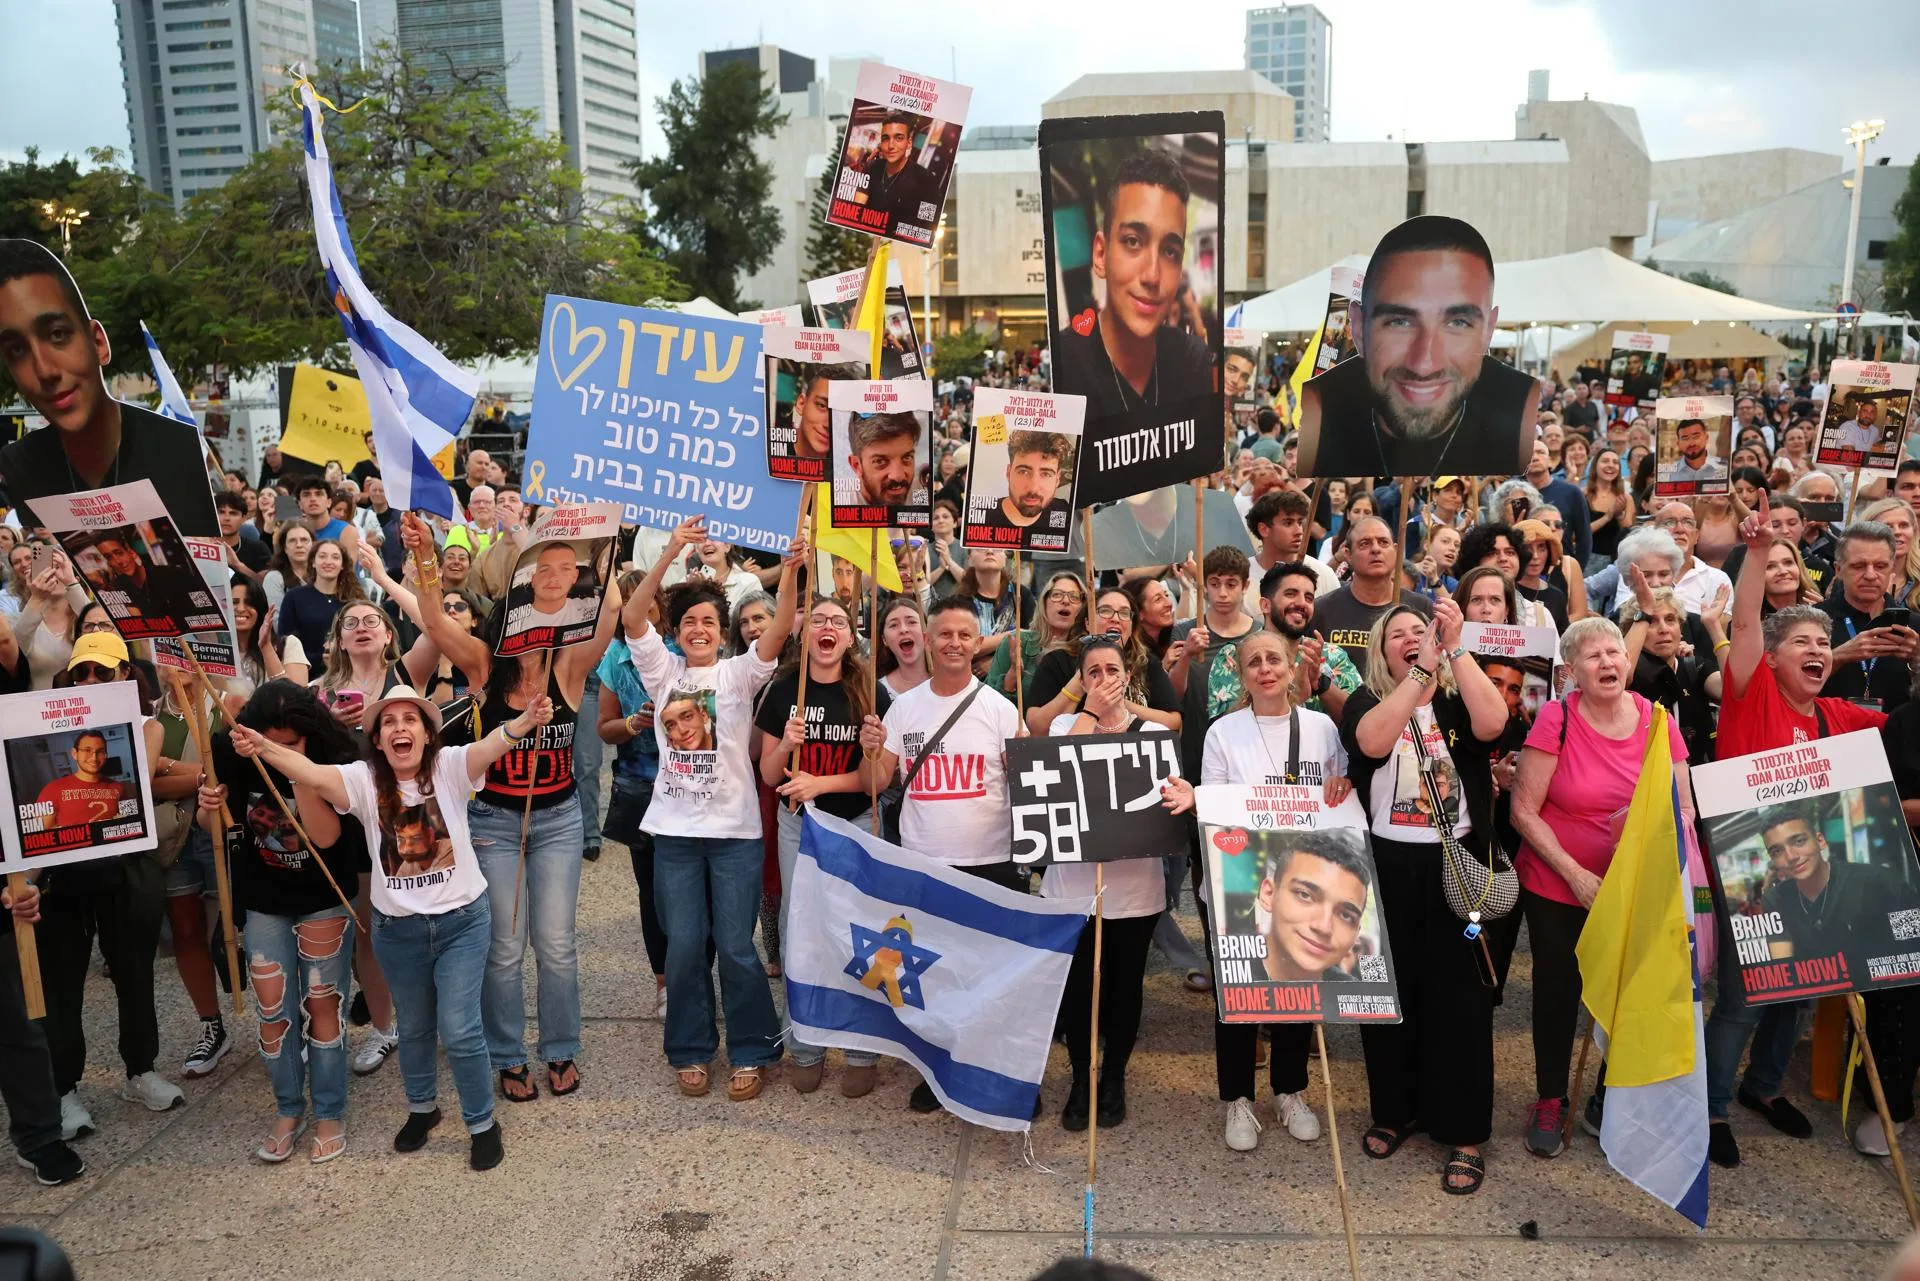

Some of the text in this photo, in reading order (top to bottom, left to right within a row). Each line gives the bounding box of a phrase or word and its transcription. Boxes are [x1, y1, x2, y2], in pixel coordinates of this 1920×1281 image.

[890, 83, 939, 103] EDAN ALEXANDER
[840, 169, 871, 189] BRING
[836, 185, 857, 202] HIM
[833, 201, 859, 222] HOME
[862, 209, 889, 228] NOW!
[617, 318, 745, 390] עידן
[794, 341, 840, 352] EDAN ALEXANDER
[811, 351, 823, 361] (20)
[864, 393, 898, 402] DAVID CUNIO
[574, 382, 760, 437] כל כל חיכינו לך
[875, 402, 887, 411] (33)
[1003, 406, 1057, 419] GUY GILBOA-DALAL
[1014, 417, 1032, 428] (23)
[770, 426, 797, 443] BRING
[1824, 428, 1847, 438] BRING
[603, 420, 736, 468] כמה טוב
[770, 441, 788, 457] HIM
[1093, 419, 1195, 472] עידן אלכסנדר
[1821, 437, 1836, 448] HIM
[771, 458, 824, 475] HOME NOW!
[571, 453, 754, 511] שאתה בבית
[833, 478, 861, 492] BRING
[833, 491, 851, 506] HIM
[969, 494, 999, 510] BRING
[570, 515, 607, 527] KUPERSHTEIN
[624, 502, 703, 530] מחזירים
[834, 506, 888, 521] HOME NOW!
[968, 509, 986, 524] HIM
[707, 520, 791, 552] ממשיכים
[966, 526, 993, 542] HOME
[995, 528, 1022, 543] NOW!
[1807, 568, 1823, 581] OW
[98, 590, 133, 604] BRING
[106, 604, 131, 619] HIM
[508, 604, 532, 623] BRING
[505, 620, 522, 637] HIM
[1508, 628, 1521, 638] עידן
[503, 633, 527, 651] HOME
[527, 628, 555, 647] NOW!
[1479, 635, 1526, 647] EDAN ALEXANDER
[192, 643, 230, 655] Berman
[157, 656, 182, 667] BRING
[208, 665, 236, 676] HOME
[41, 705, 91, 720] TAMIR NIMRODI
[790, 704, 824, 722] BING
[51, 719, 70, 729] (20)
[824, 725, 858, 742] HOME
[903, 732, 925, 744] BRING
[1752, 746, 1818, 772] עידן אלכסנדר
[905, 754, 986, 792] NOW!
[1746, 758, 1832, 788] EDAN ALEXANDER
[1058, 738, 1181, 833] עידן
[1252, 786, 1311, 799] עידן אלכסנדר
[19, 800, 54, 819] BRING
[1245, 800, 1320, 813] EDAN ALEXANDER
[1393, 804, 1413, 812] GUY
[22, 818, 44, 834] HIM
[1011, 802, 1083, 863] 58
[24, 831, 56, 850] HOME
[58, 824, 91, 844] NOW!
[1218, 835, 1247, 847] חזרתי
[403, 877, 414, 890] לך
[417, 871, 444, 887] מחכים
[1730, 911, 1784, 942] BRING
[1218, 935, 1267, 959] BRING
[1736, 940, 1772, 966] HIM
[1867, 952, 1920, 967] HOSTAGES AND MIS
[1221, 960, 1253, 984] HIM
[1741, 951, 1850, 993] HOME NOW!
[1868, 962, 1908, 979] FAMILIES
[1223, 984, 1321, 1012] HOME NOW!
[1338, 1002, 1396, 1015] FAMILIES FORUM
